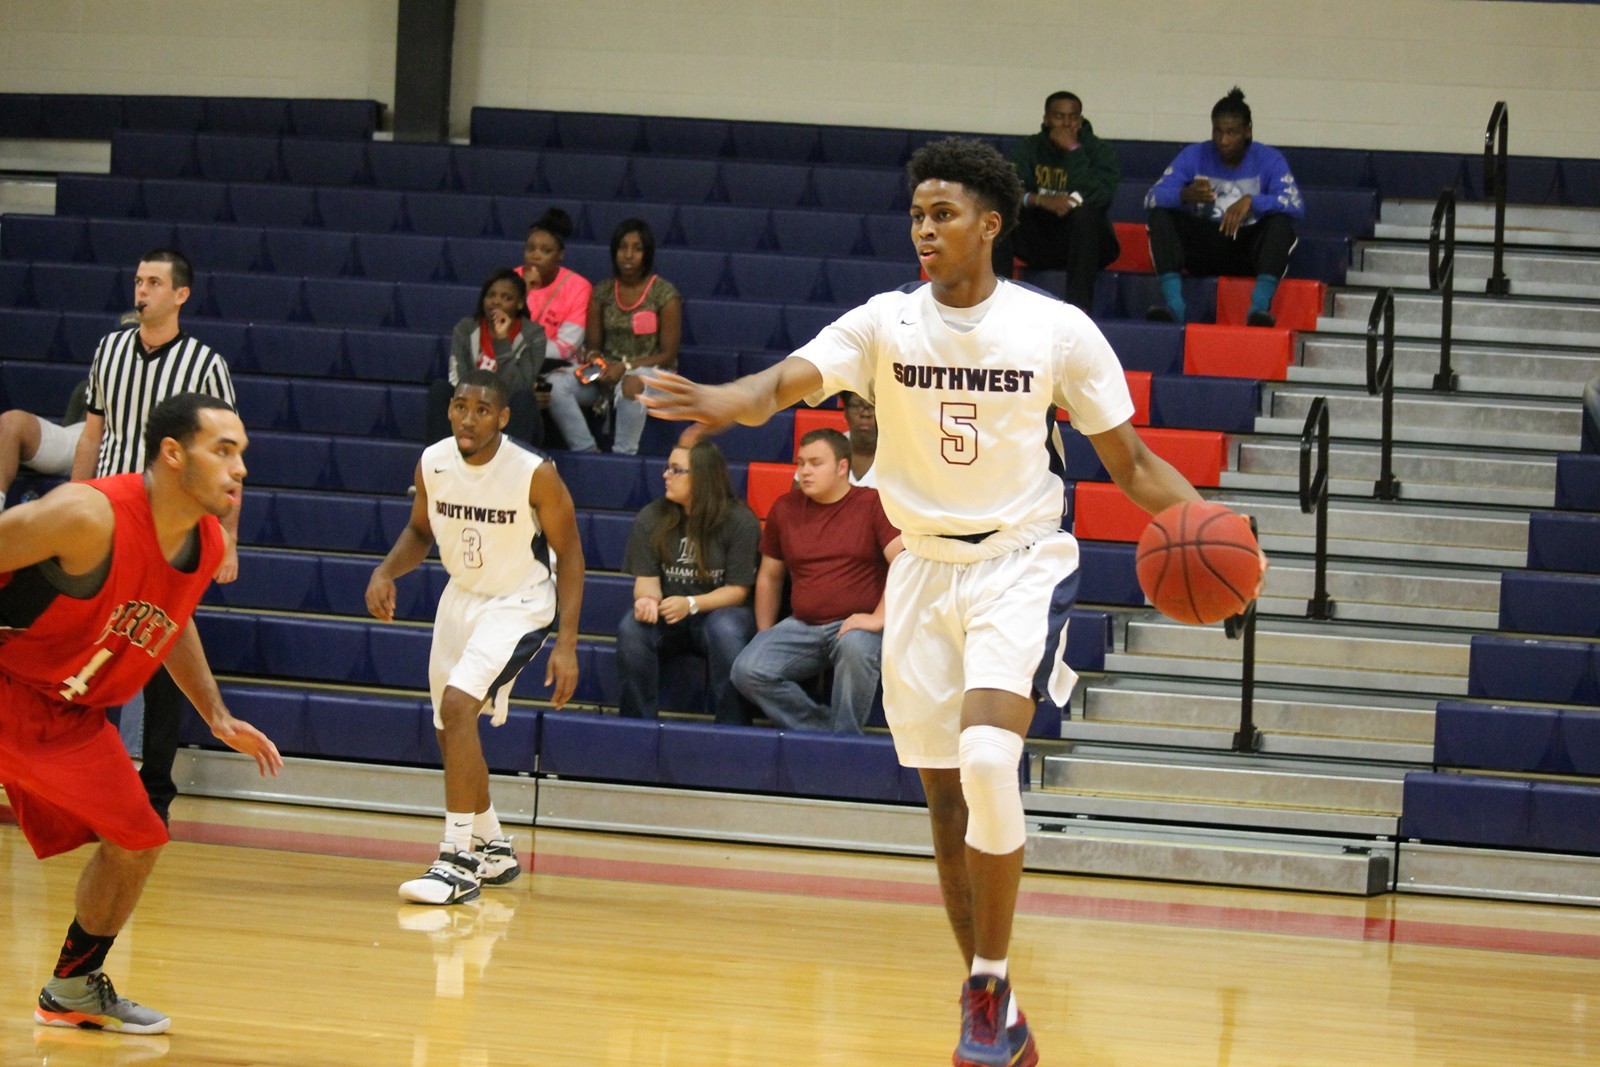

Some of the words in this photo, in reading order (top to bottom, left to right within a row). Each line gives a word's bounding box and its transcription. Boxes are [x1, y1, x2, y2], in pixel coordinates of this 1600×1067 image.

[892, 362, 1034, 393] SOUTHWEST
[940, 401, 978, 466] 5
[436, 500, 517, 525] SOUTHWEST
[461, 527, 483, 569] 3
[58, 647, 114, 701] 1
